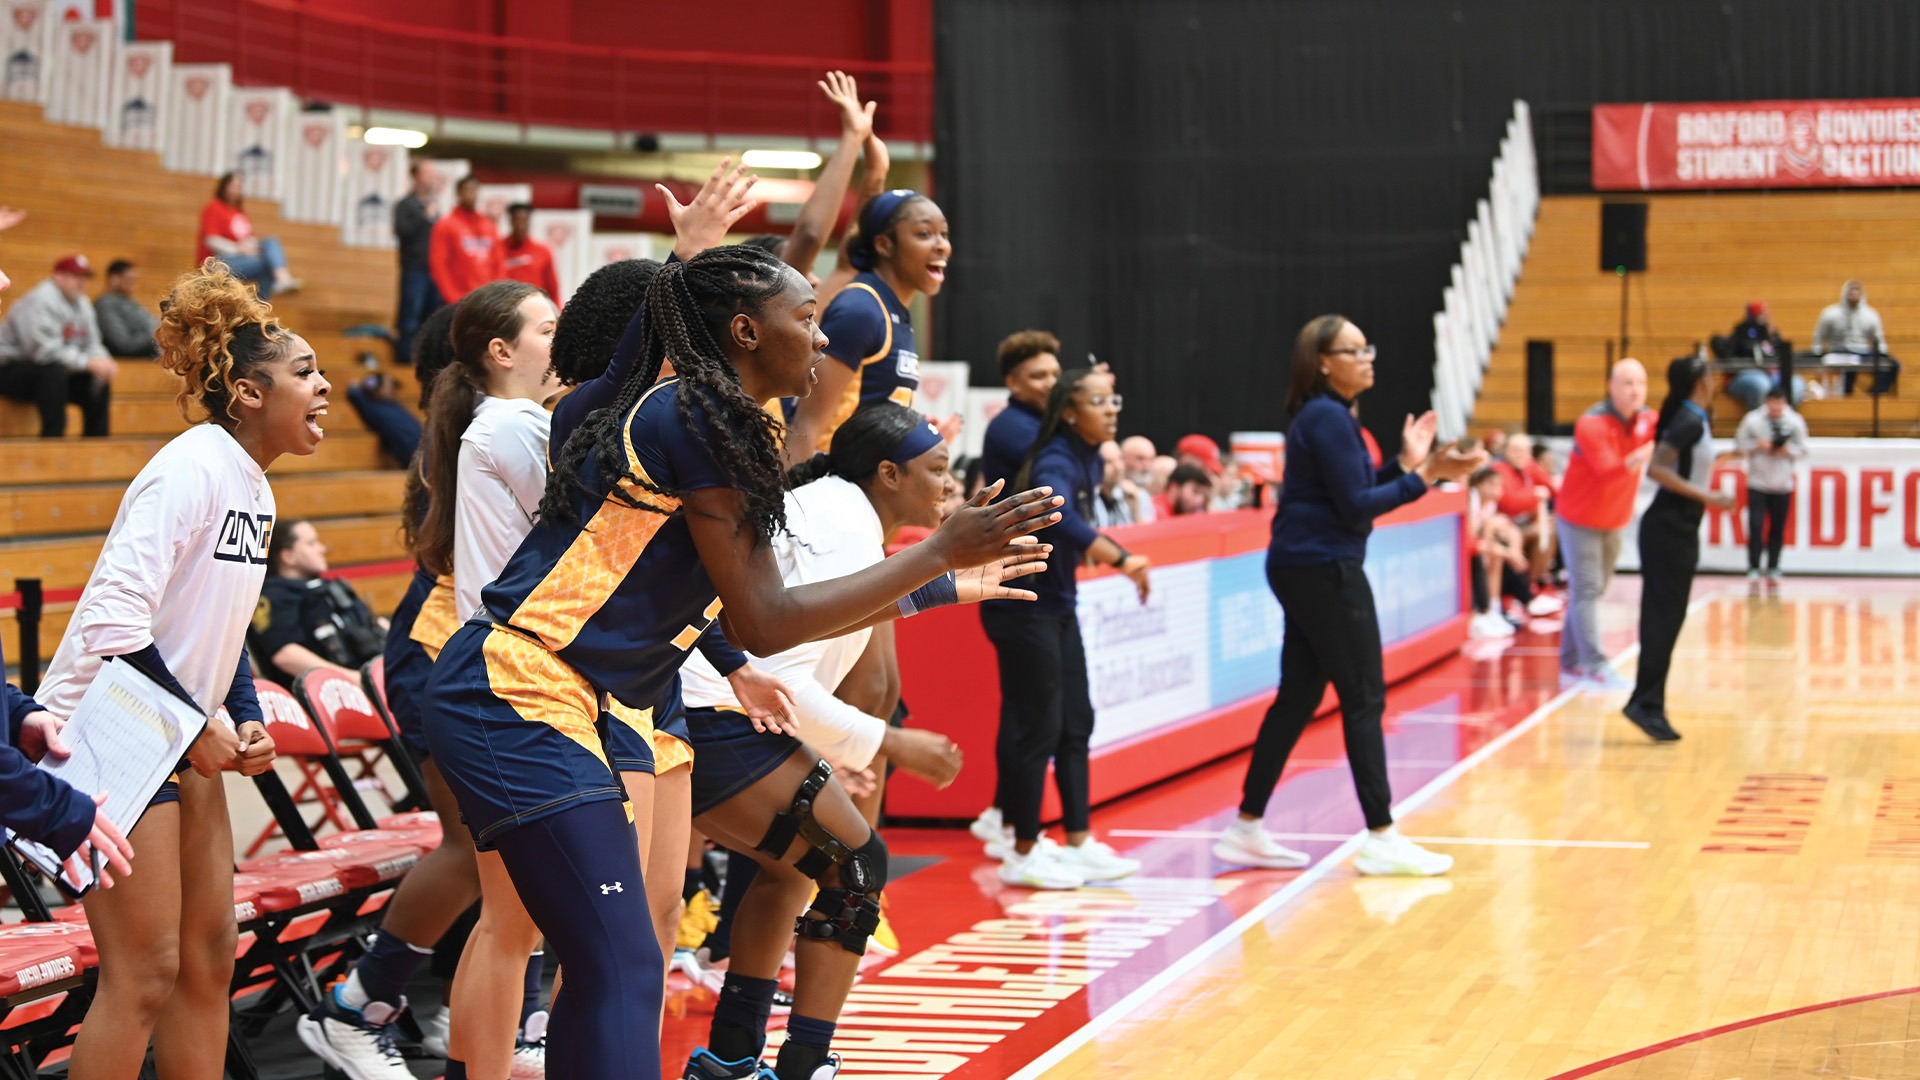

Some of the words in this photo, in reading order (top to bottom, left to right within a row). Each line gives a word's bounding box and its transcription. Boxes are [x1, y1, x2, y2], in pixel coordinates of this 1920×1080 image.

[1677, 111, 1786, 146] RADFORD
[1817, 109, 1920, 144] ROWDIES
[1676, 147, 1778, 180] STUDENT
[1822, 144, 1920, 178] SECTION
[1704, 468, 1920, 549] RDF
